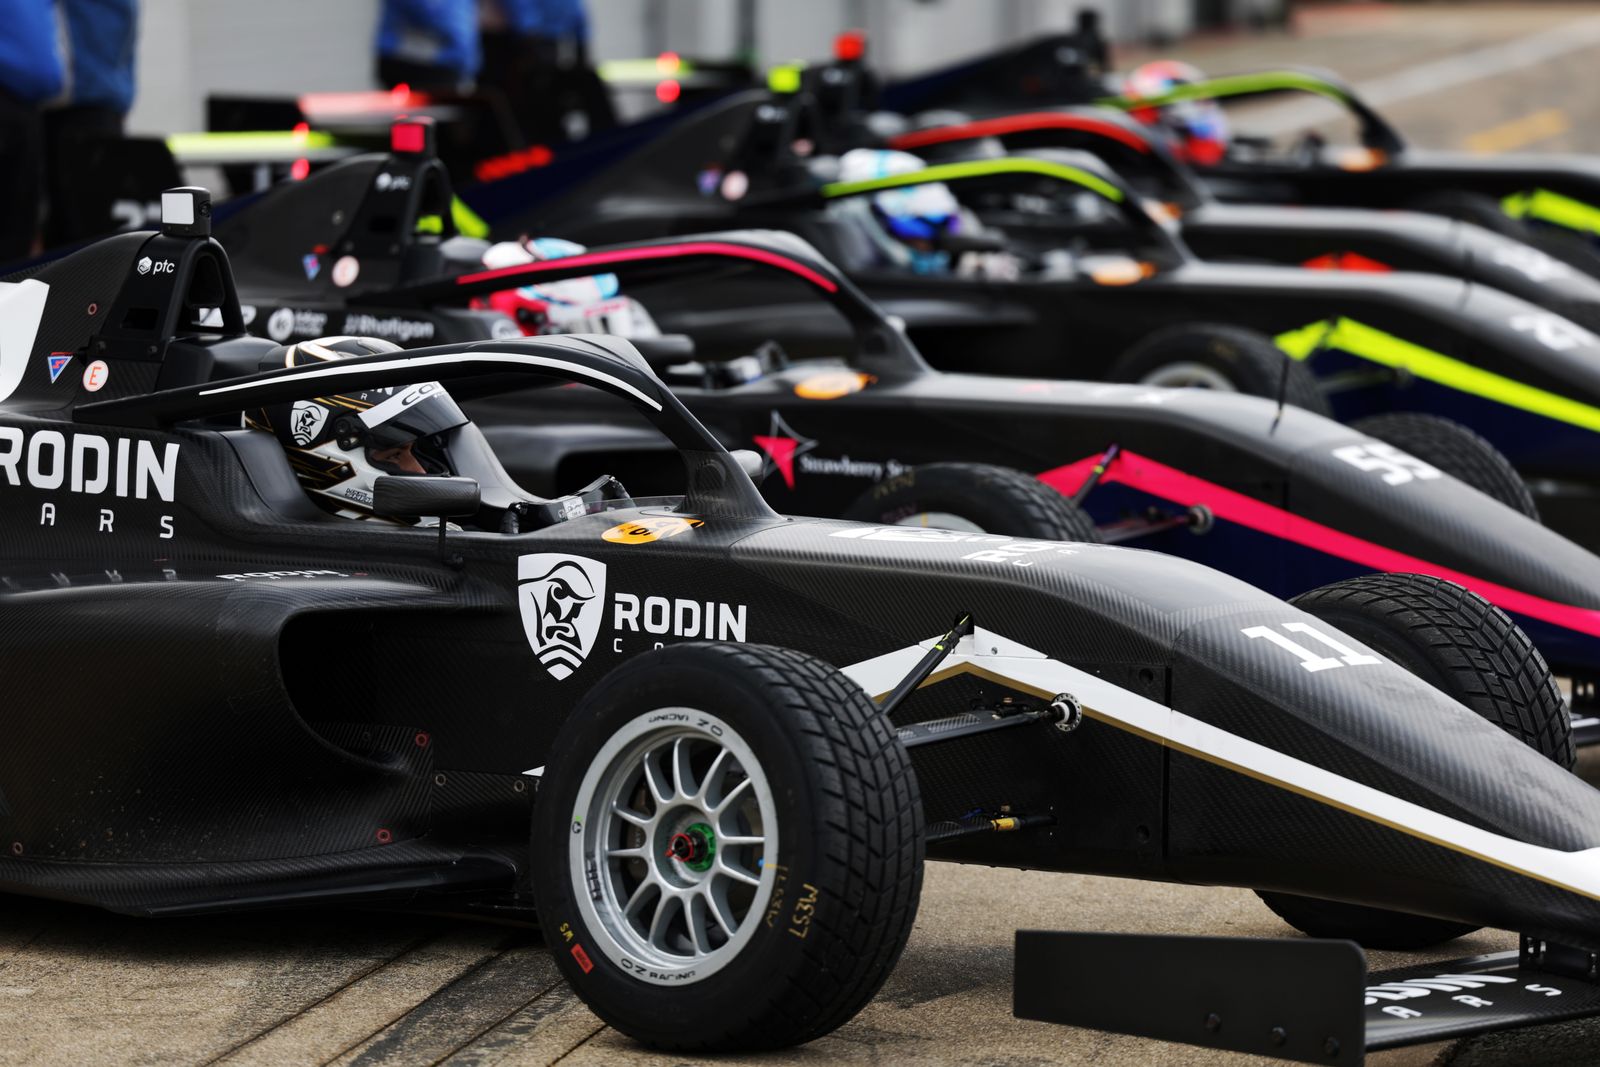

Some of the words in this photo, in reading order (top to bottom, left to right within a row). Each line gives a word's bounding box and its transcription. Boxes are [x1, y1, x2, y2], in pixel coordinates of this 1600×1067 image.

[152, 259, 175, 275] ptc
[88, 366, 103, 386] E
[0, 426, 180, 502] RODIN
[800, 453, 884, 482] Strawberry
[1332, 443, 1442, 486] 55
[40, 502, 175, 539] ARS
[614, 592, 747, 643] RODIN
[1241, 622, 1383, 673] 11
